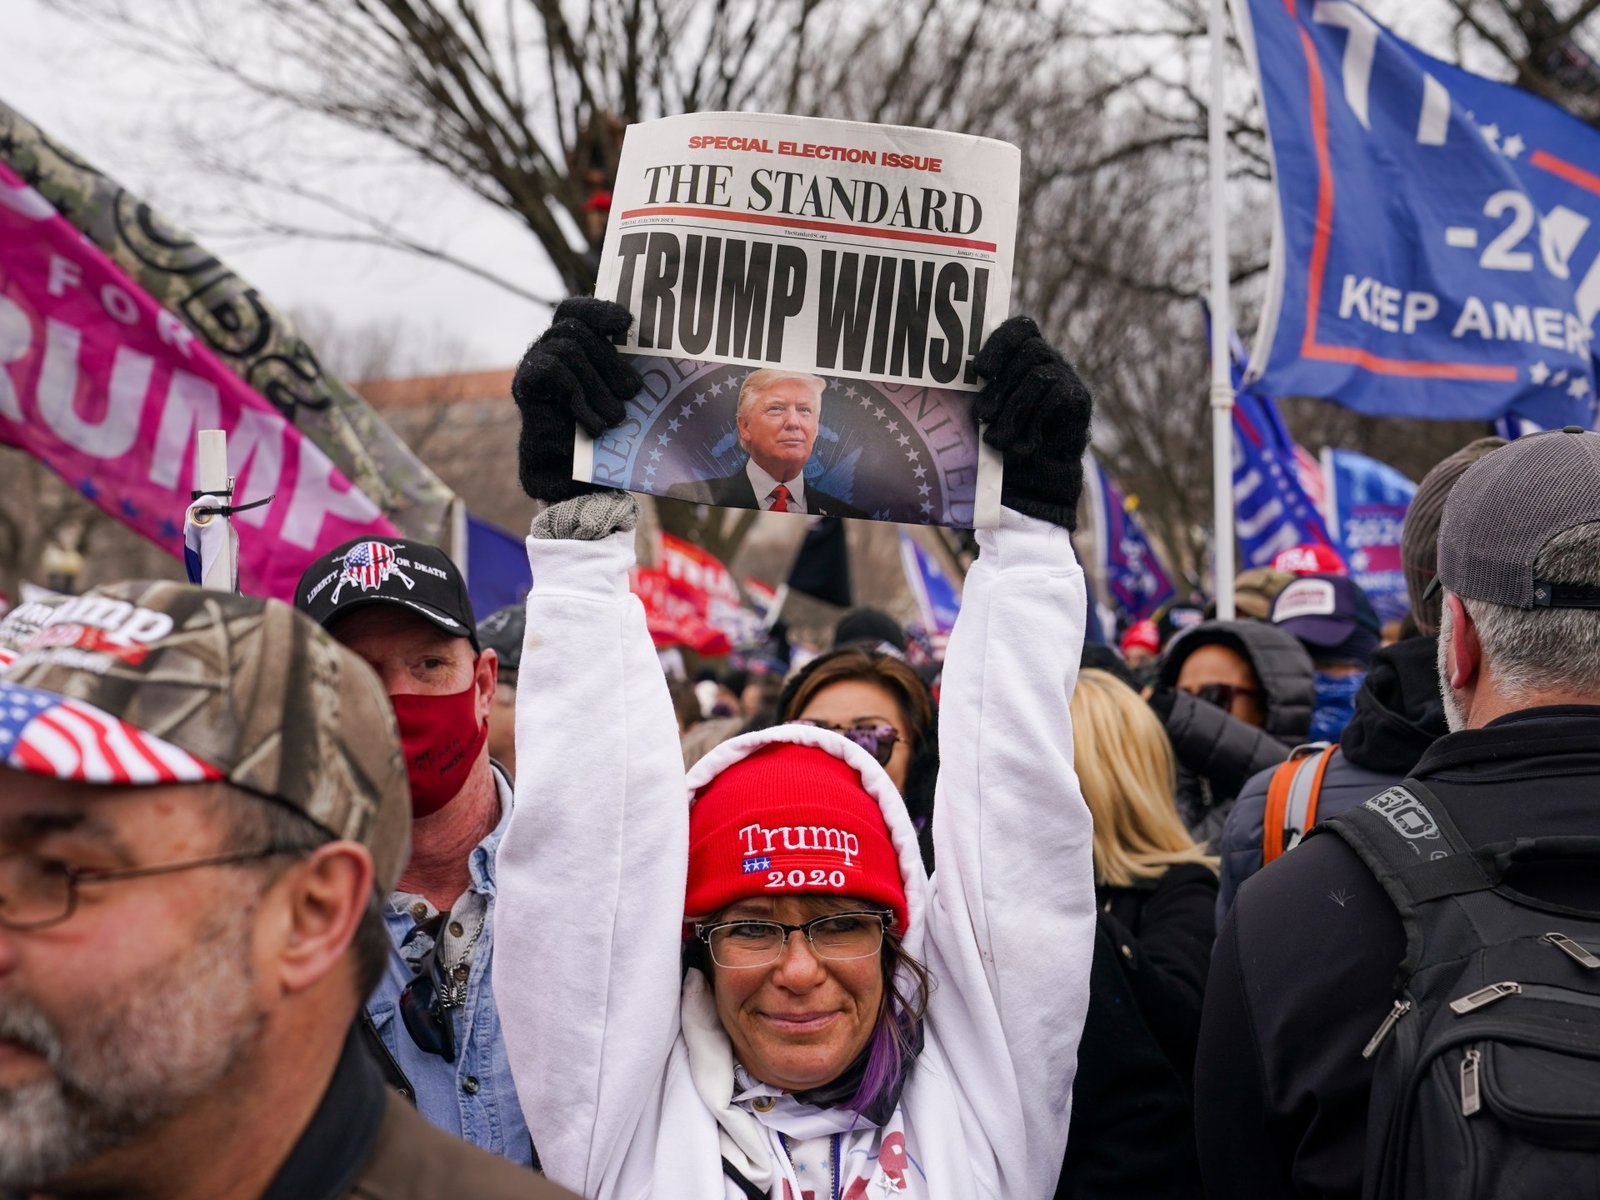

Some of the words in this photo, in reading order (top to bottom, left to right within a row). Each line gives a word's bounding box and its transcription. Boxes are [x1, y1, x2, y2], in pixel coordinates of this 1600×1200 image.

[688, 134, 773, 155] SPECIAL
[778, 140, 877, 166] ELECTION
[881, 151, 942, 173] ISSUE
[644, 163, 733, 207] THE
[747, 167, 983, 235] STANDARD
[611, 231, 808, 363] TRUMP
[816, 248, 990, 385] WINS!
[306, 569, 339, 605] LIBERTY
[396, 556, 411, 567] OR
[414, 561, 448, 581] DEATH
[739, 823, 859, 867] Trump
[764, 869, 845, 888] 2020
